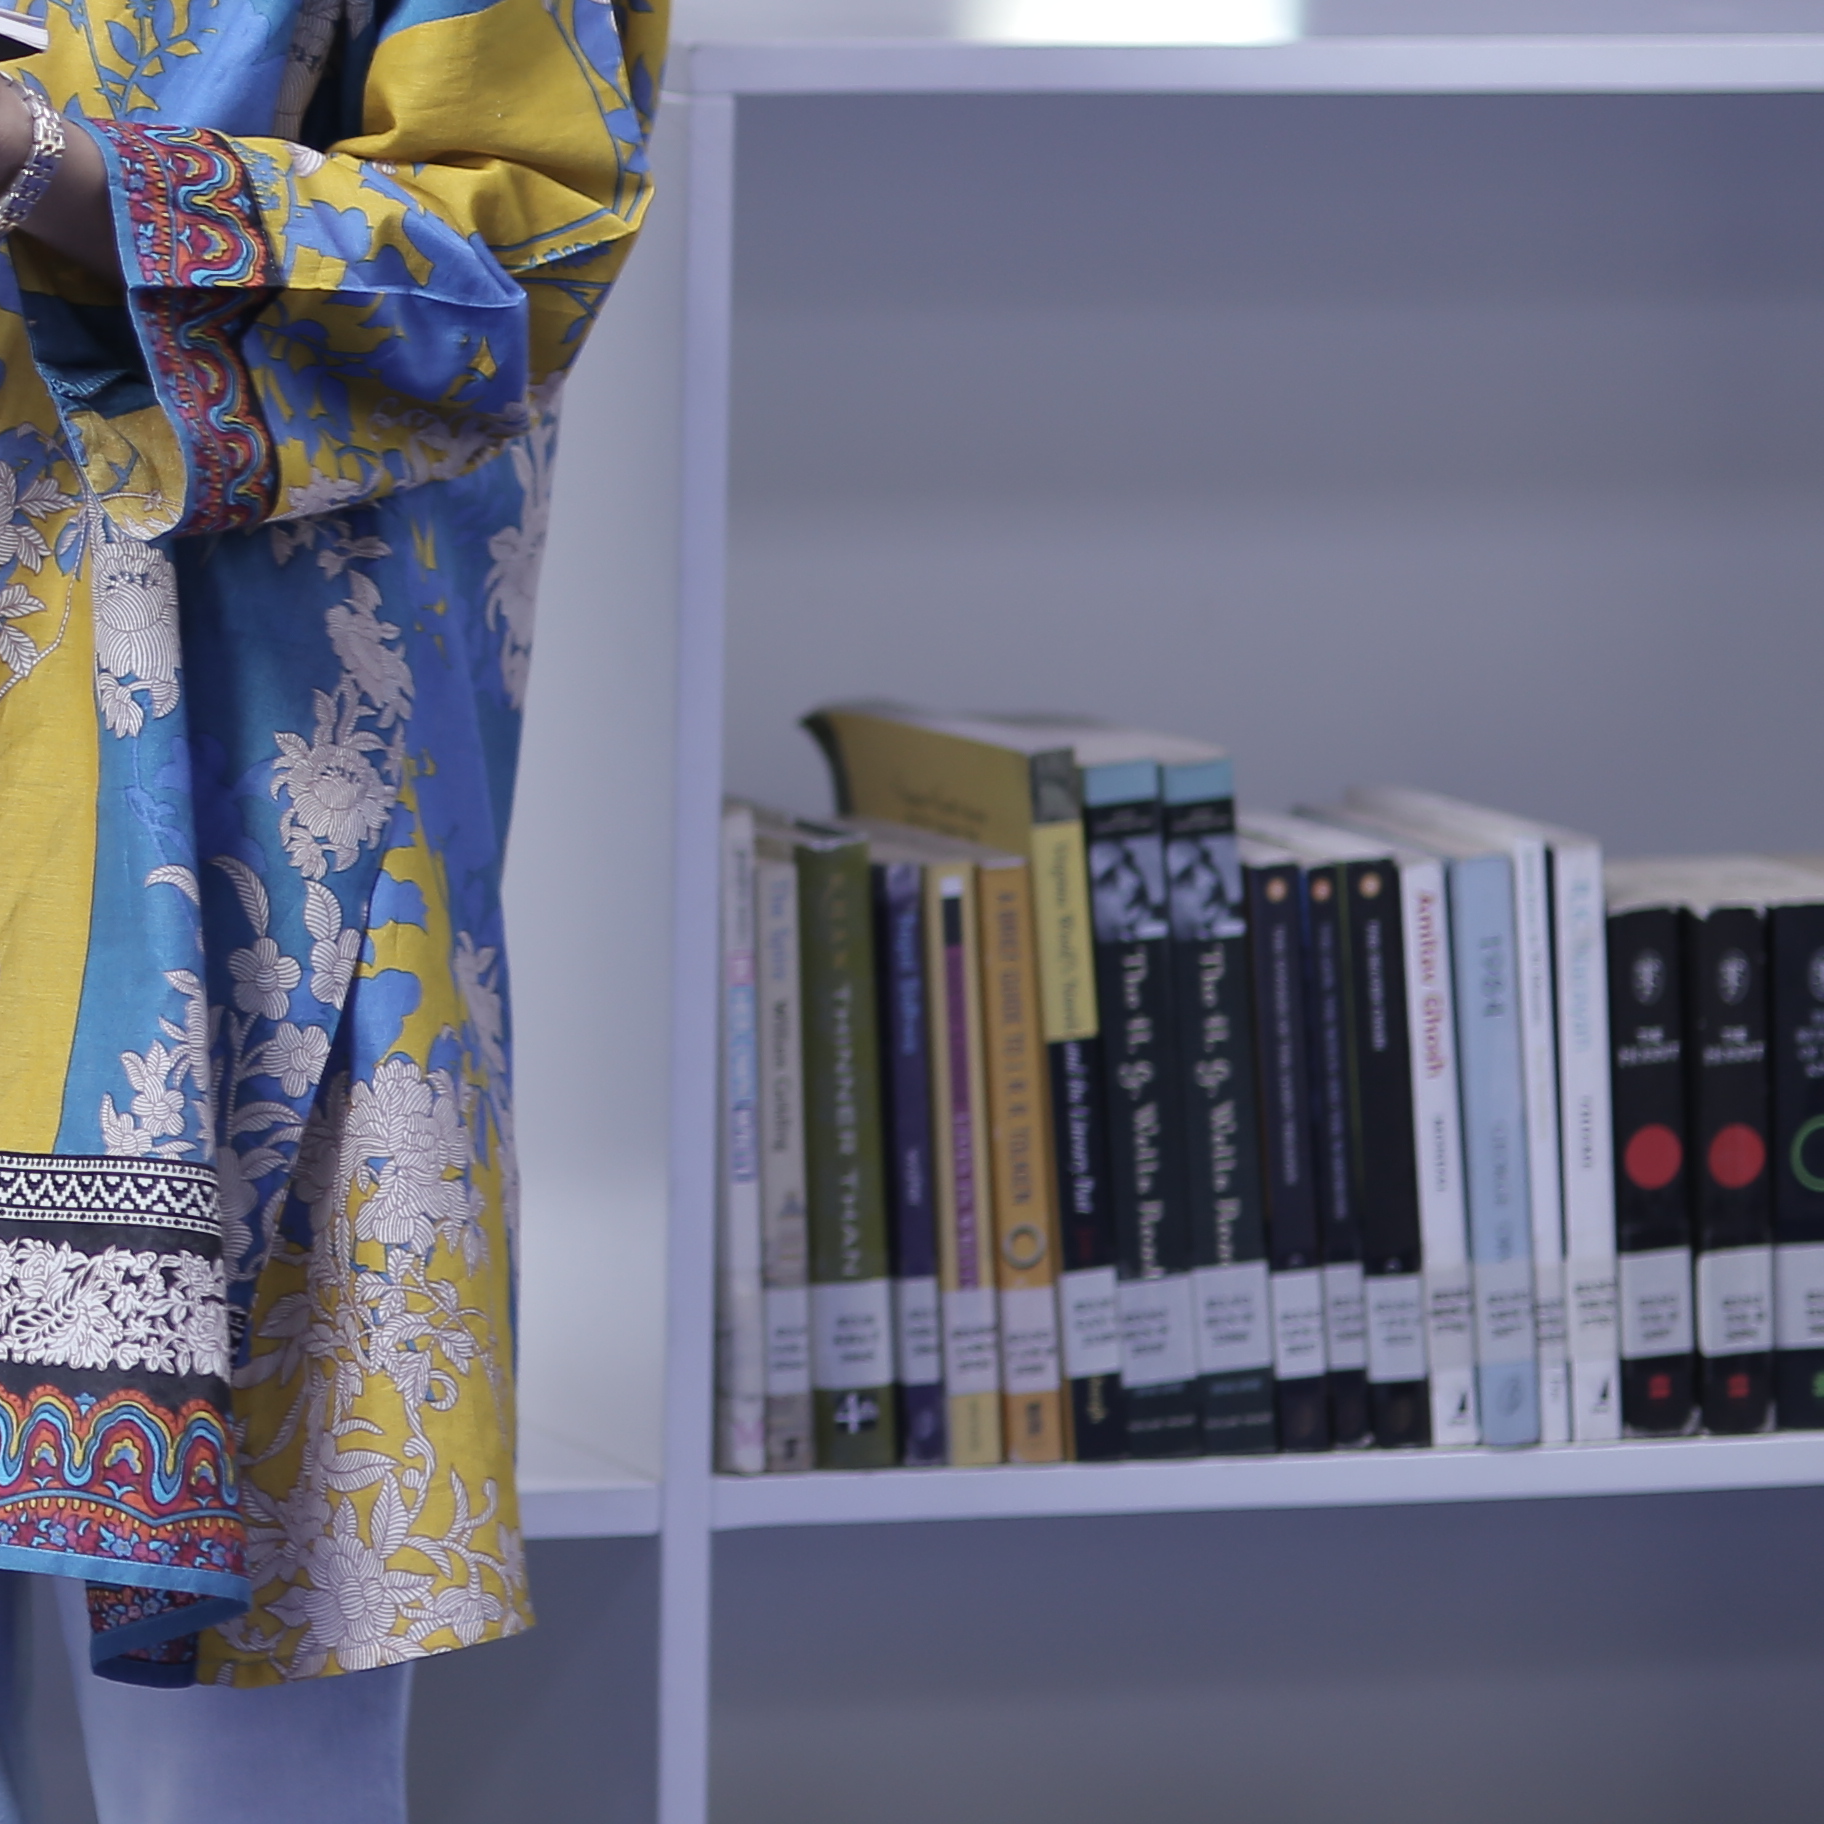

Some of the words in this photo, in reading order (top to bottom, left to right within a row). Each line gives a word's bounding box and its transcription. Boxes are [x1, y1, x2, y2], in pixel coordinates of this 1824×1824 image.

[770, 879, 791, 917] The
[1415, 892, 1438, 982] Amitav
[1121, 945, 1149, 1010] The
[1198, 943, 1227, 1008] The
[1479, 934, 1508, 1019] 1984
[772, 1000, 791, 1068] William
[831, 983, 858, 1155] THINNER
[1423, 993, 1446, 1080] Ghosh
[1131, 1101, 1162, 1196] Wells
[1209, 1100, 1239, 1193] Wells
[839, 1168, 862, 1276] THAN
